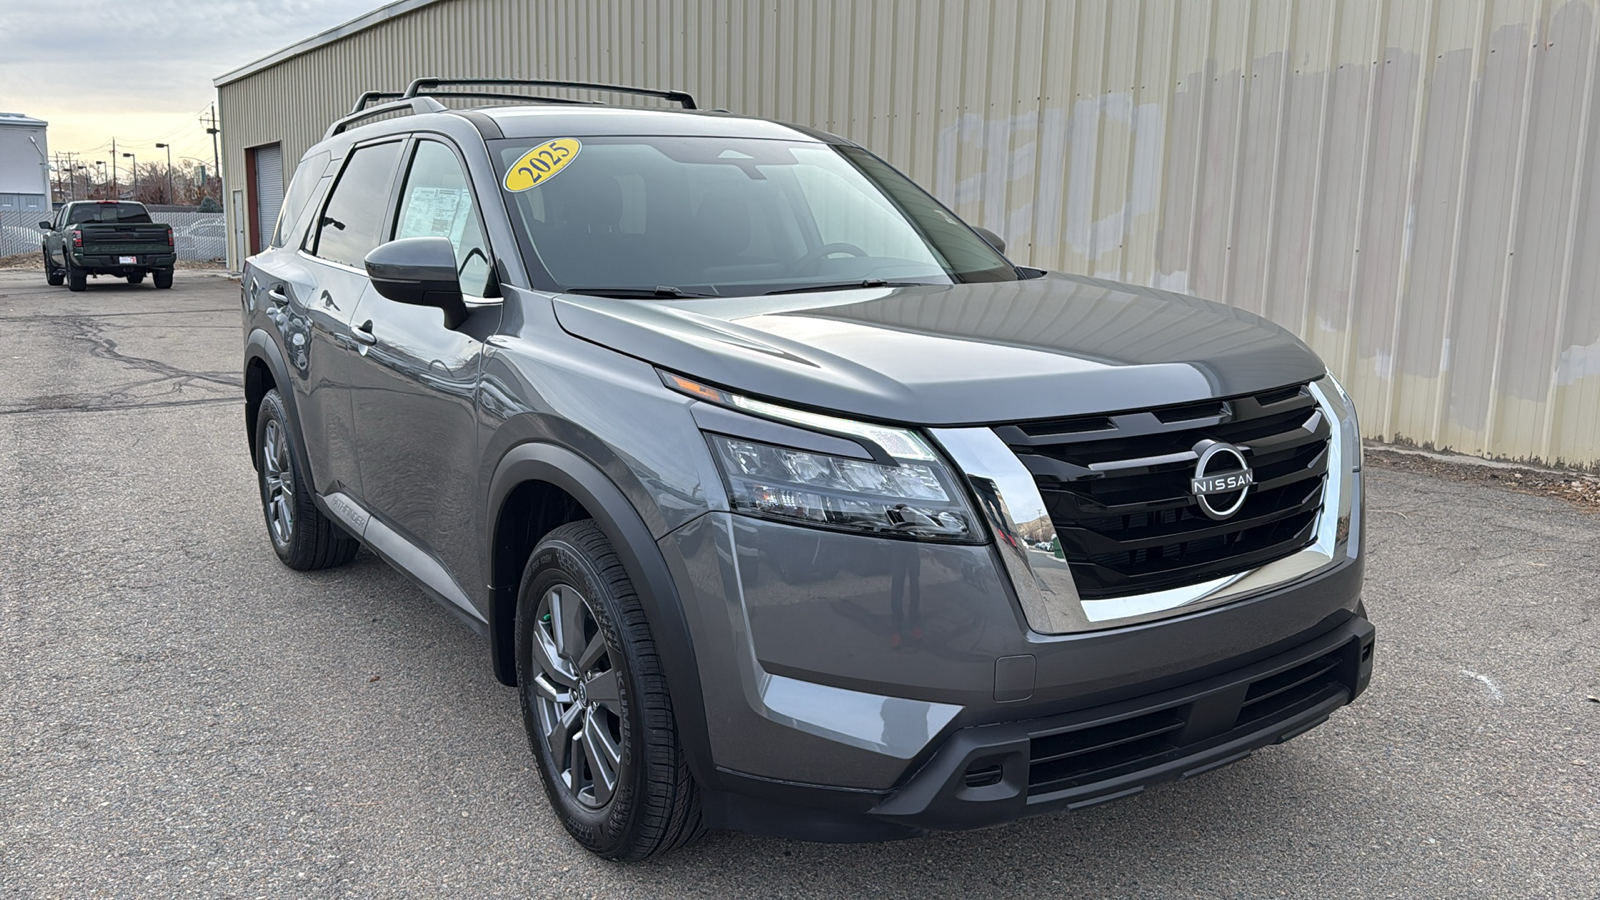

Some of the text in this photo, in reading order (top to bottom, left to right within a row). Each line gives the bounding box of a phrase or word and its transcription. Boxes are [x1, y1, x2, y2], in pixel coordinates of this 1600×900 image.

[518, 142, 569, 183] 2025
[1194, 473, 1253, 493] NISSAN
[331, 496, 365, 528] PATHFINDER
[617, 670, 631, 766] KUMHO
